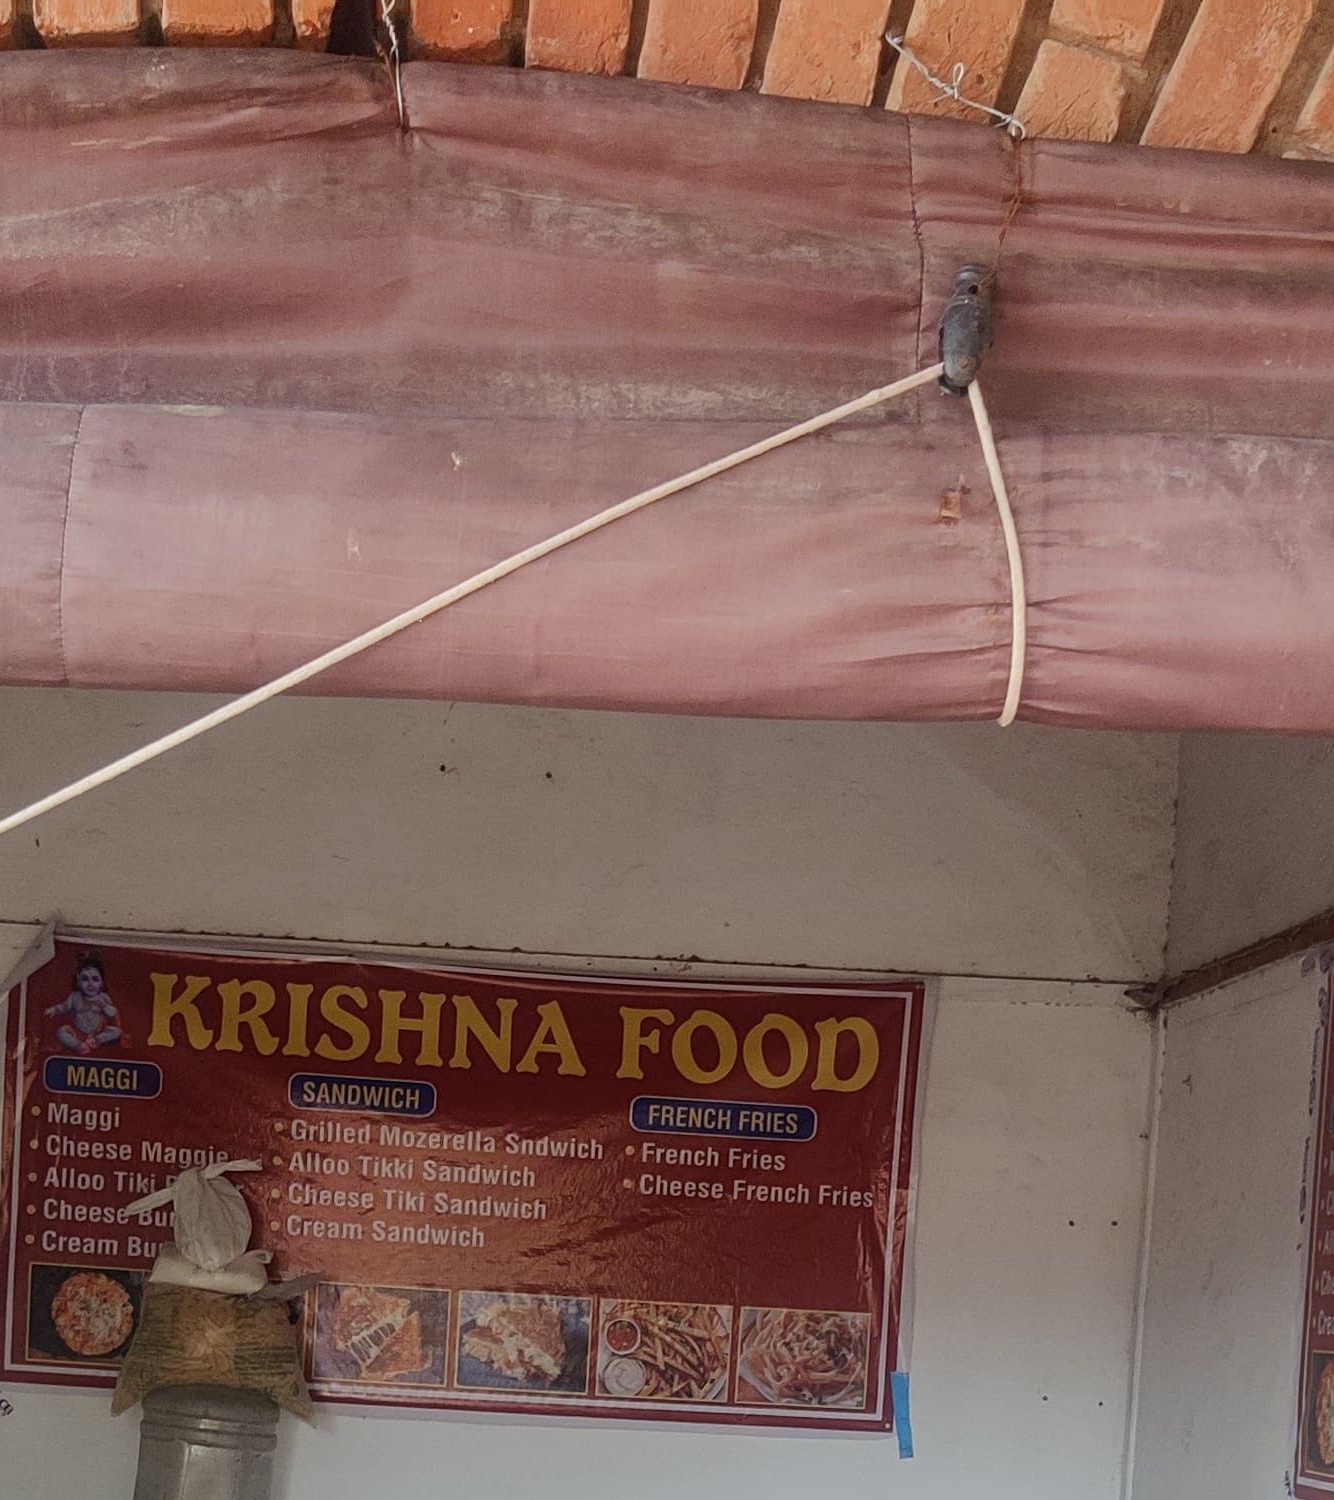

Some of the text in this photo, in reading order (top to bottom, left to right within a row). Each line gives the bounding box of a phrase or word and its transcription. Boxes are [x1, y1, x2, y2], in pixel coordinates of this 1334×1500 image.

[147, 972, 880, 1093] KRISHNA FOOD
[67, 1064, 138, 1091] MAGGI
[302, 1081, 421, 1110] SANDWICH
[47, 1103, 121, 1131] Maggi
[648, 1105, 799, 1135] FRENCH FRIES
[46, 1135, 229, 1168] Cheese Maggie
[290, 1119, 604, 1160] Grilled Mozerella Sndwich
[289, 1151, 536, 1187] Alloo Tikki Sandwich
[641, 1142, 786, 1172] French Fries
[43, 1167, 105, 1191] Alloo
[113, 1170, 156, 1194] Tiki
[640, 1175, 875, 1208] Cheese French Fries
[43, 1199, 130, 1225] Cheese
[287, 1183, 548, 1221] Cheese Tiki Sandwich
[42, 1230, 118, 1256] Cream
[286, 1215, 486, 1249] Cream Sandwich
